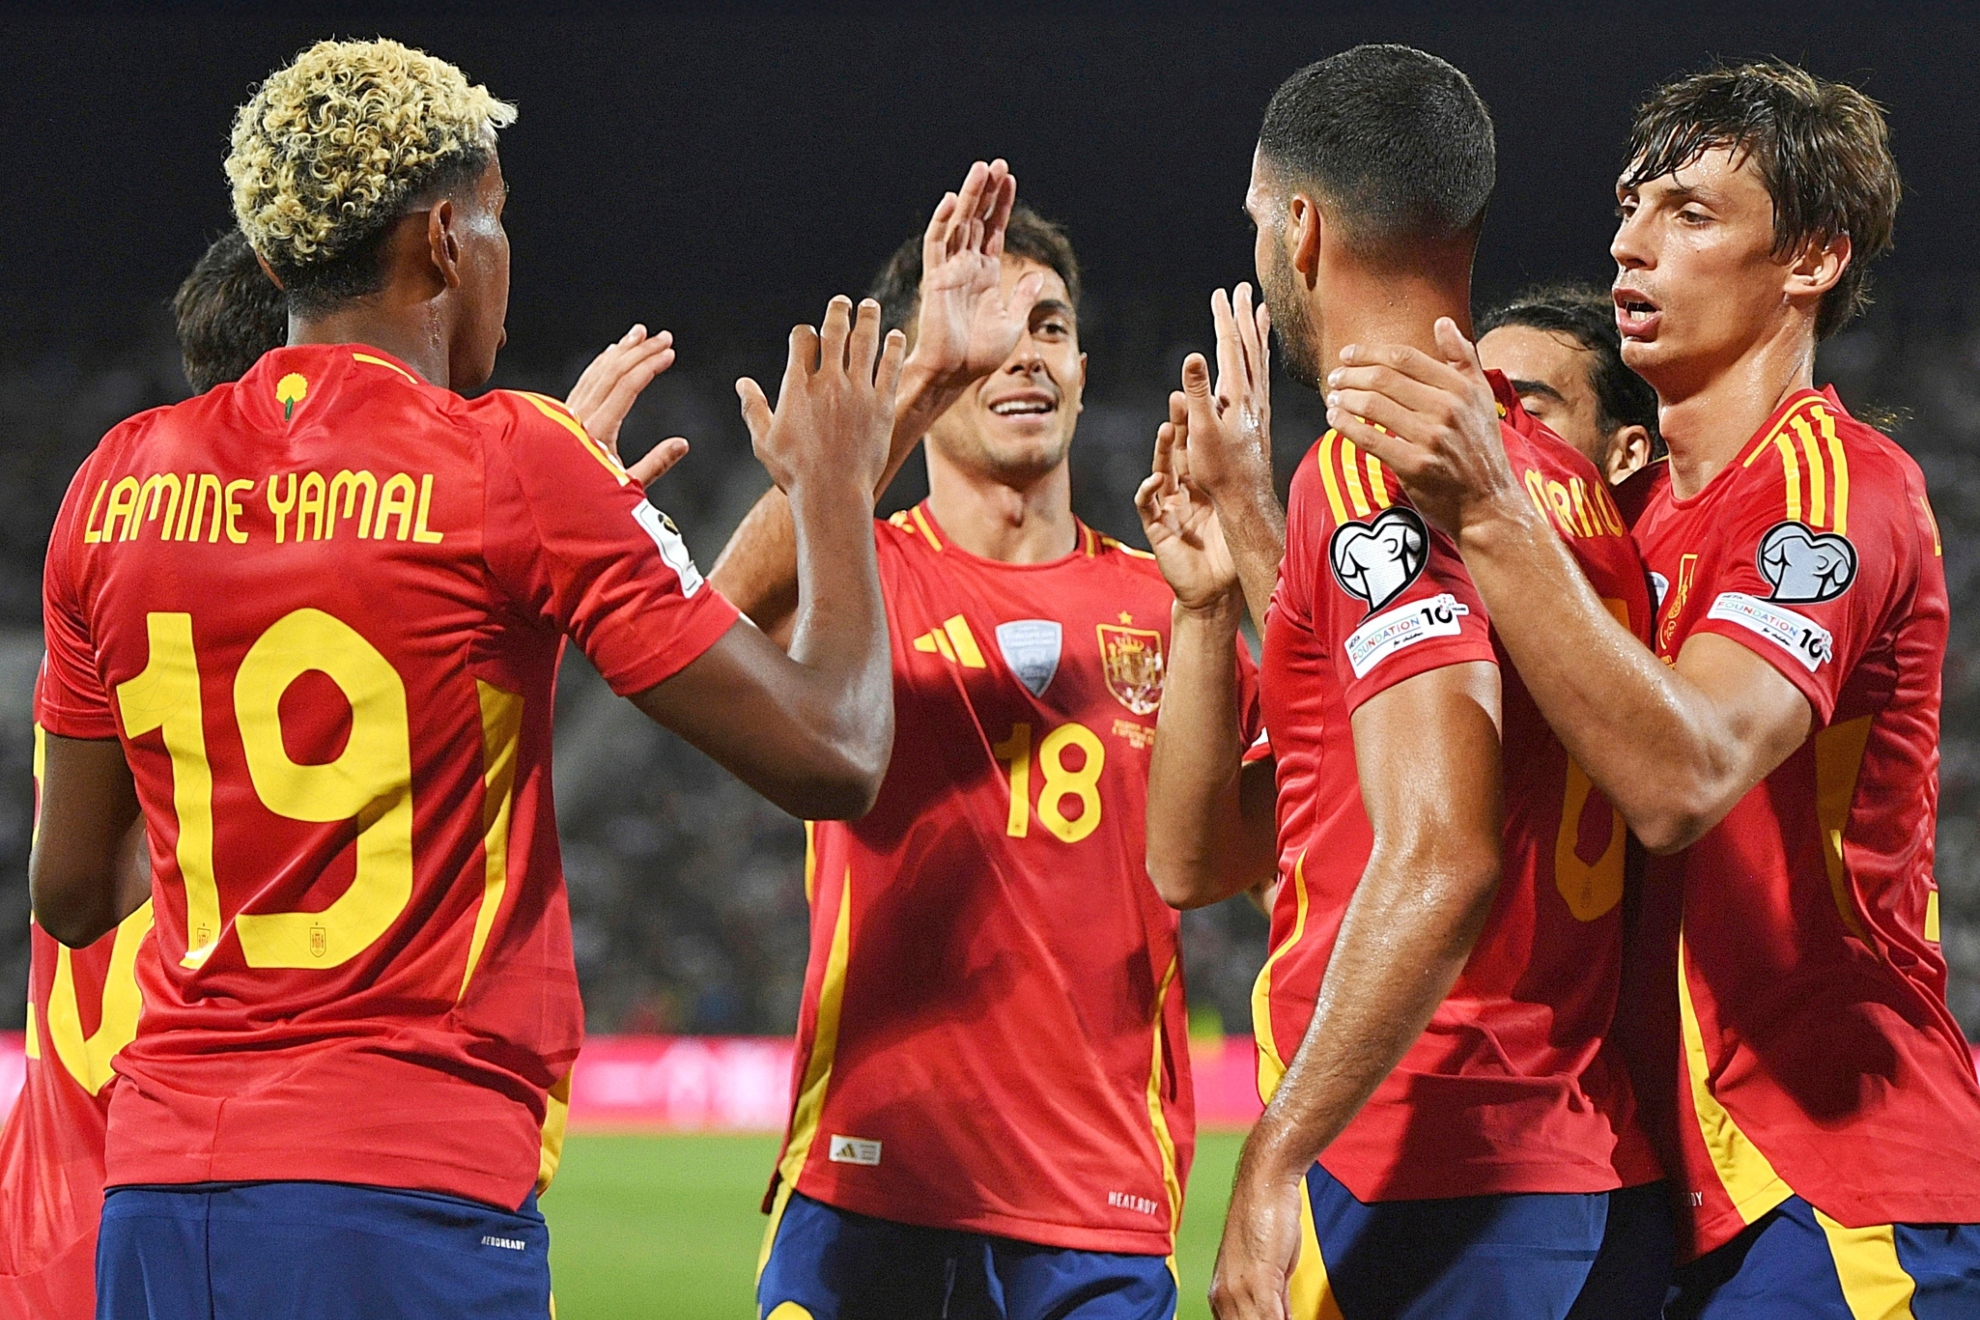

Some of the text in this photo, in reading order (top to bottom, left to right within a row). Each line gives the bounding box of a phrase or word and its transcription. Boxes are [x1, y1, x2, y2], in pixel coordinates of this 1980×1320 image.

[84, 469, 444, 544] LAMINE YAMAL
[1352, 617, 1421, 663] FOUNDATION
[1717, 601, 1799, 637] FOUNDATION
[115, 607, 413, 970] 19
[993, 721, 1106, 844] 18
